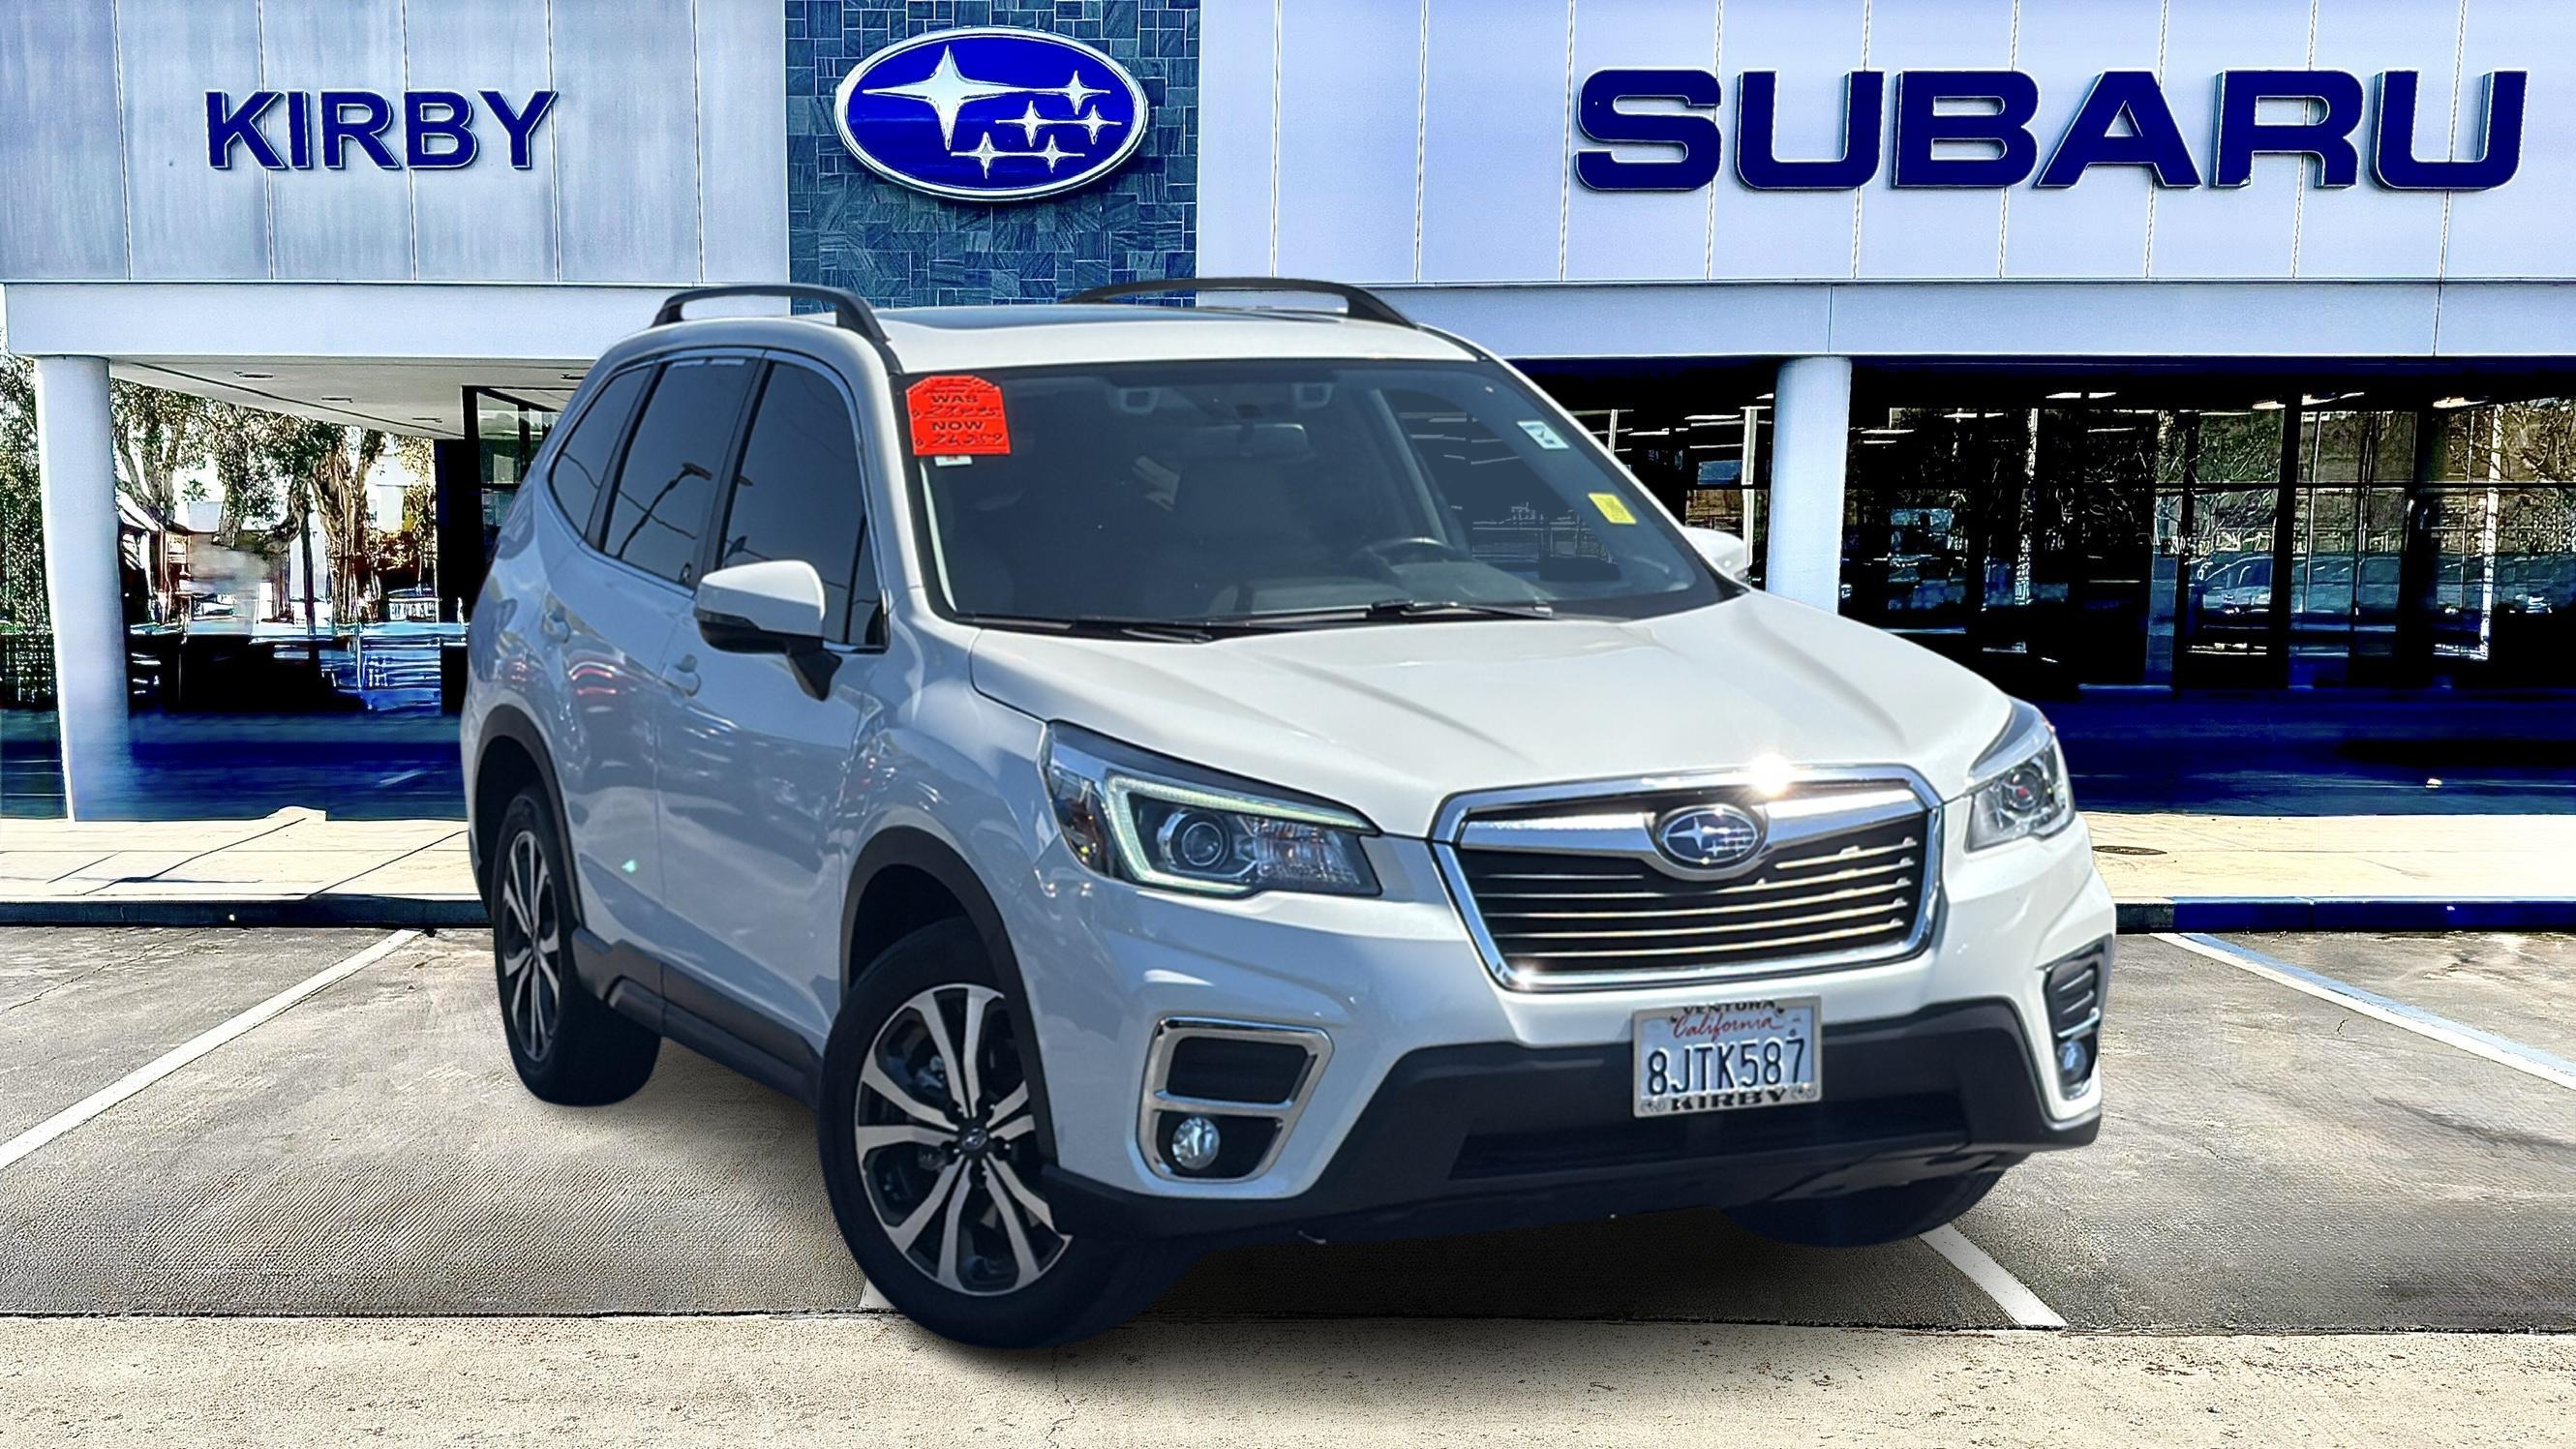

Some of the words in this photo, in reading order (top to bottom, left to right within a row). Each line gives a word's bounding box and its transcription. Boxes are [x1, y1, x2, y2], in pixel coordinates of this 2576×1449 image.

[205, 89, 560, 170] KIRBY
[1572, 67, 2529, 192] SUBARU
[930, 394, 980, 404] WAS
[931, 420, 985, 432] NOW
[1673, 1011, 1783, 1043] California
[1648, 1038, 1806, 1097] 8JTK587
[1671, 1088, 1787, 1111] KIRBY
